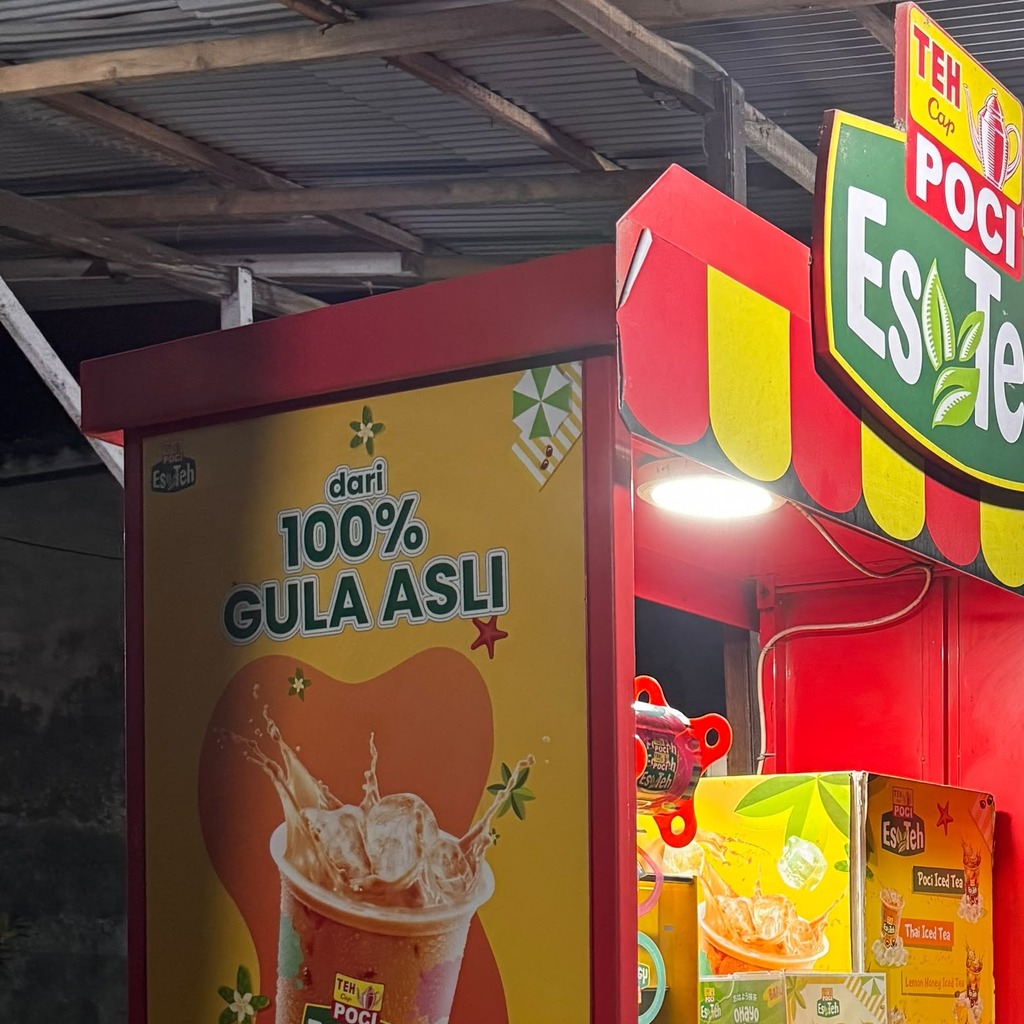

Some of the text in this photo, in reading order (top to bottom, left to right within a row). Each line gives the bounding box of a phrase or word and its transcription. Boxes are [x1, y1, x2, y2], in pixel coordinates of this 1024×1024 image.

[912, 24, 962, 110] TEH
[926, 96, 956, 138] Cap
[914, 131, 1017, 269] POCI
[846, 185, 923, 386] Es
[152, 462, 195, 489] Es Teh
[327, 459, 385, 500] dari
[279, 496, 427, 569] 100%
[221, 553, 508, 641] GULA ASLI
[639, 772, 672, 789] Es Teh
[894, 805, 913, 819] POCI
[882, 820, 924, 851] Es Teh
[917, 871, 963, 889] Poci Iced Tea
[904, 923, 921, 938] Thai
[921, 924, 937, 940] Iced
[937, 926, 951, 941] Tea
[336, 977, 356, 995] TEH
[905, 976, 966, 990] Lemon Honey Iced Tea
[817, 1002, 839, 1014] Es Teh
